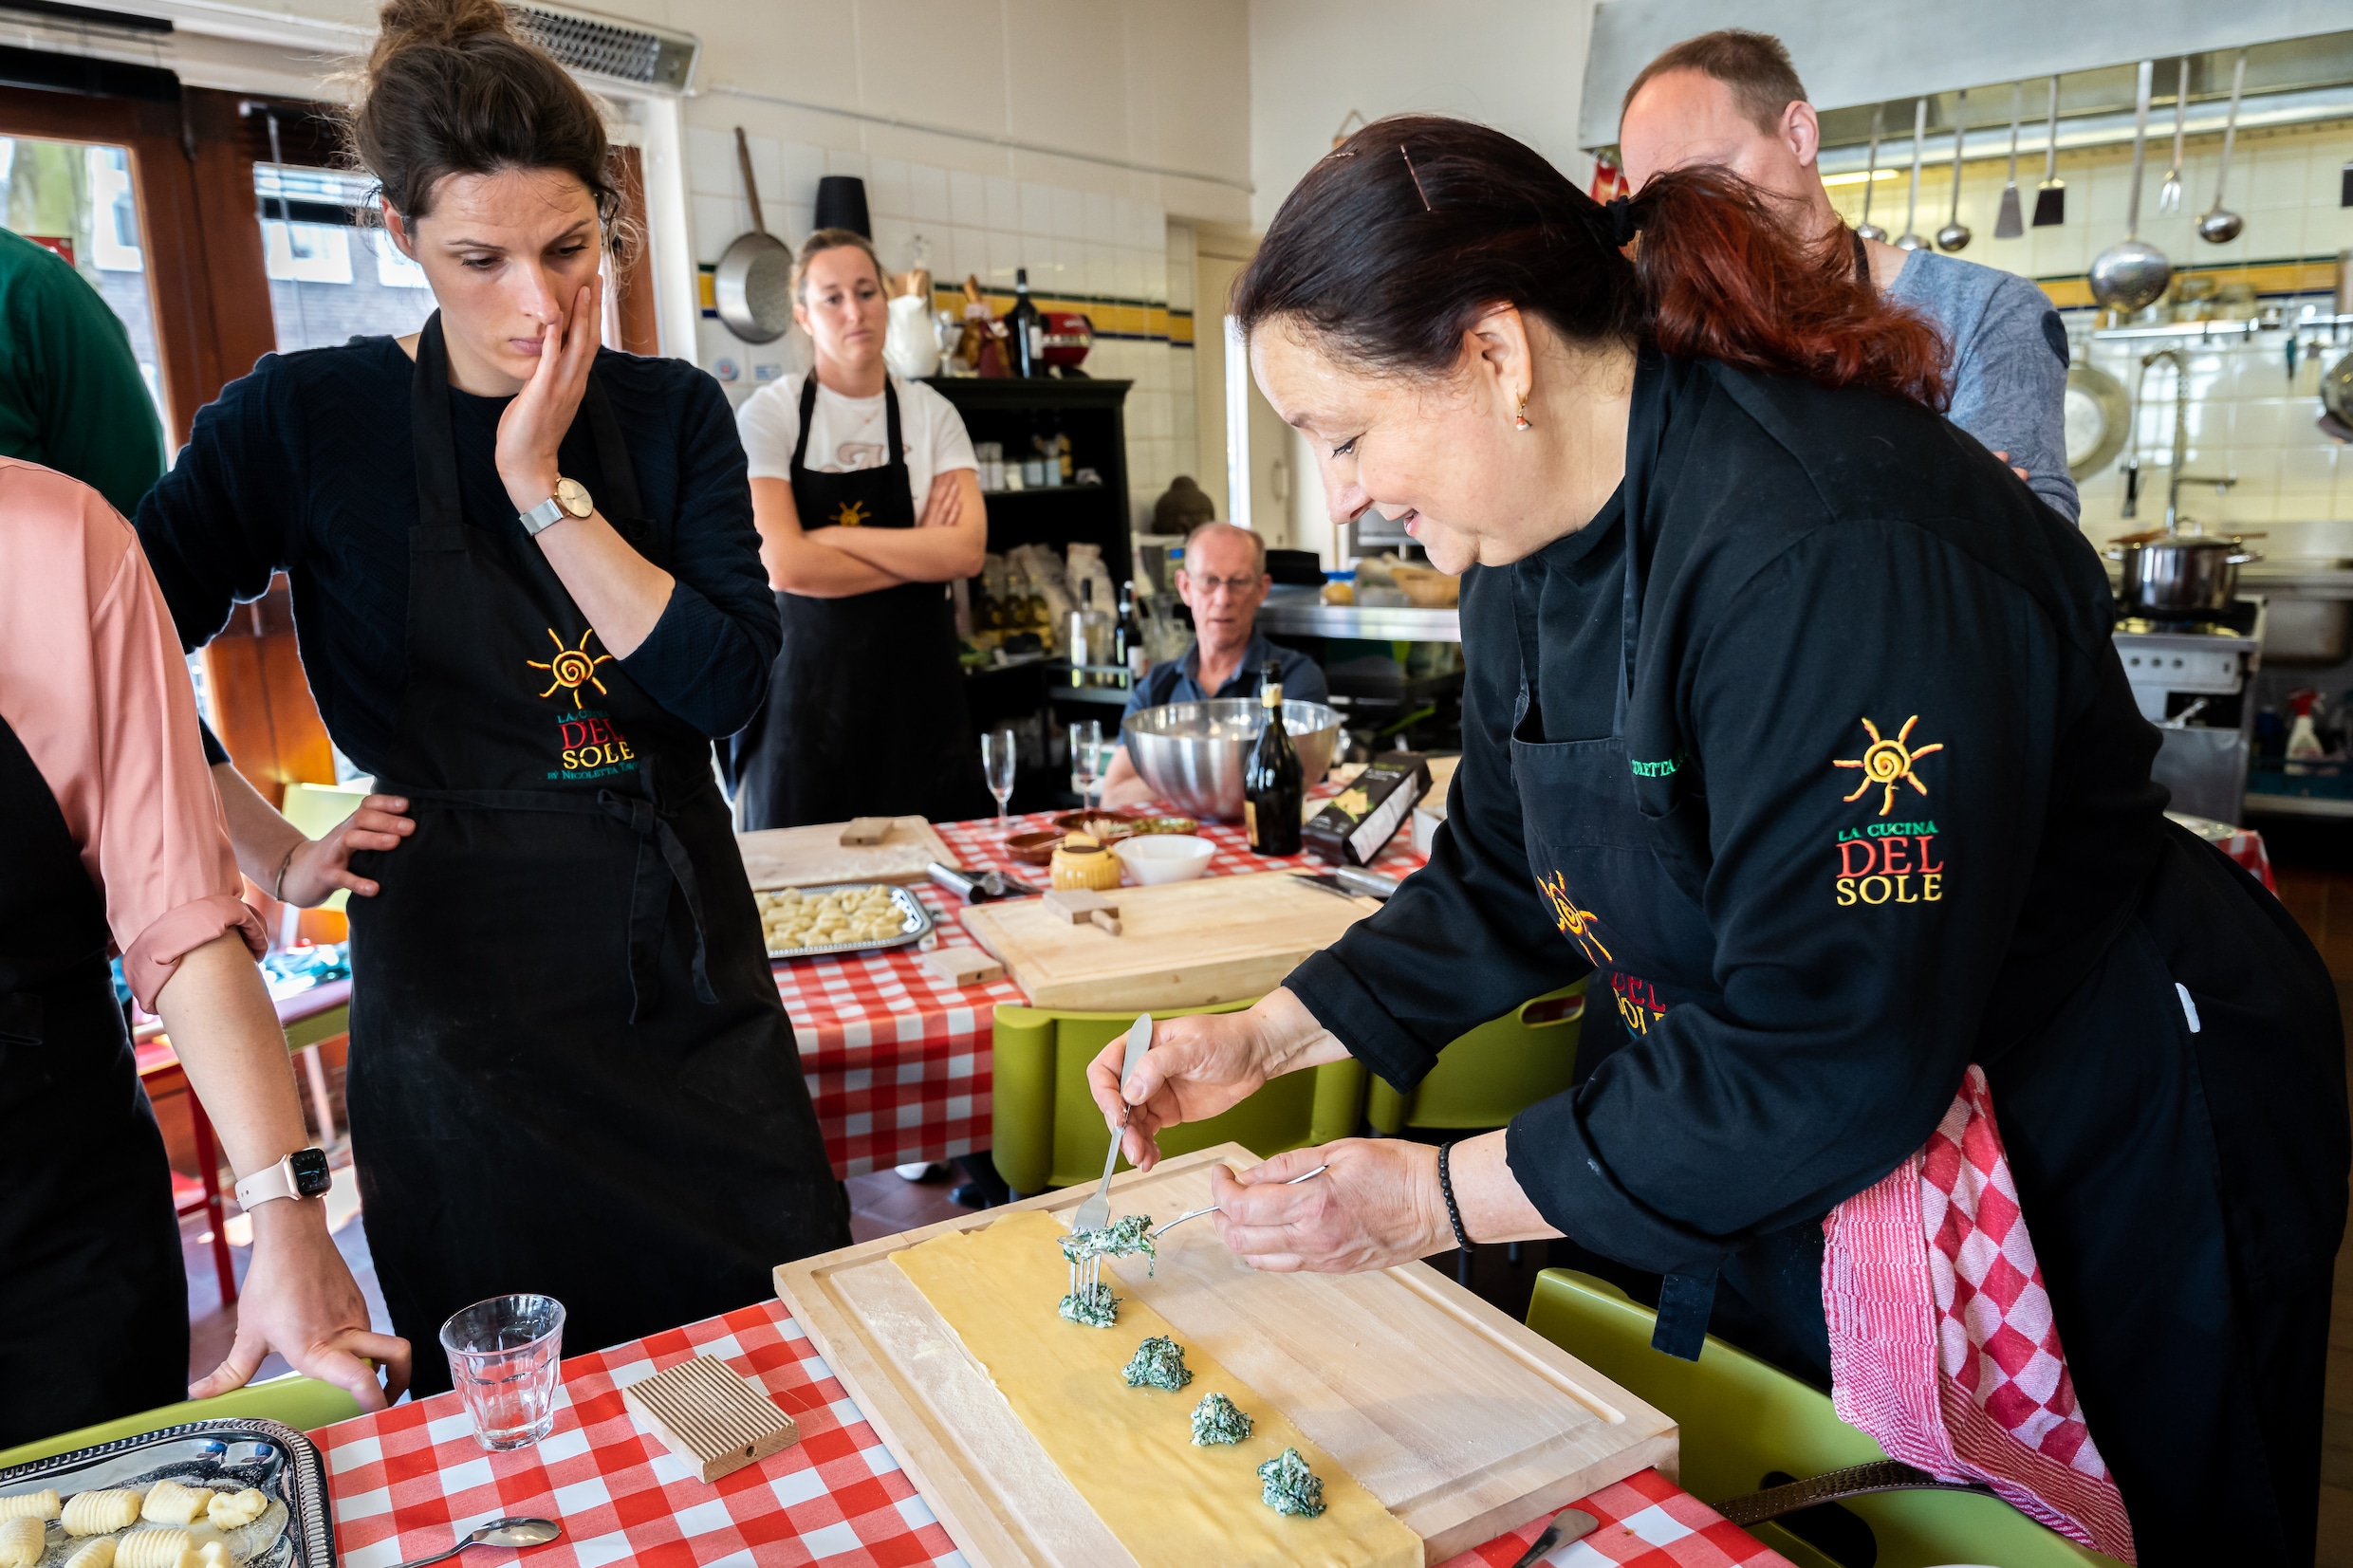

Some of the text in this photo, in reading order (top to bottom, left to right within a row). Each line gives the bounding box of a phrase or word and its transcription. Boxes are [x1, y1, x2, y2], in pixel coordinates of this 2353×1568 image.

[557, 712, 576, 724] LA
[558, 717, 625, 750] DEL
[562, 741, 635, 770] SOLE
[1631, 758, 1677, 778] OLETTA
[562, 766, 620, 781] NICOLETTA
[1838, 820, 1939, 841] LA CUCINA
[1835, 835, 1945, 879] DEL
[1836, 874, 1943, 906] SOLE
